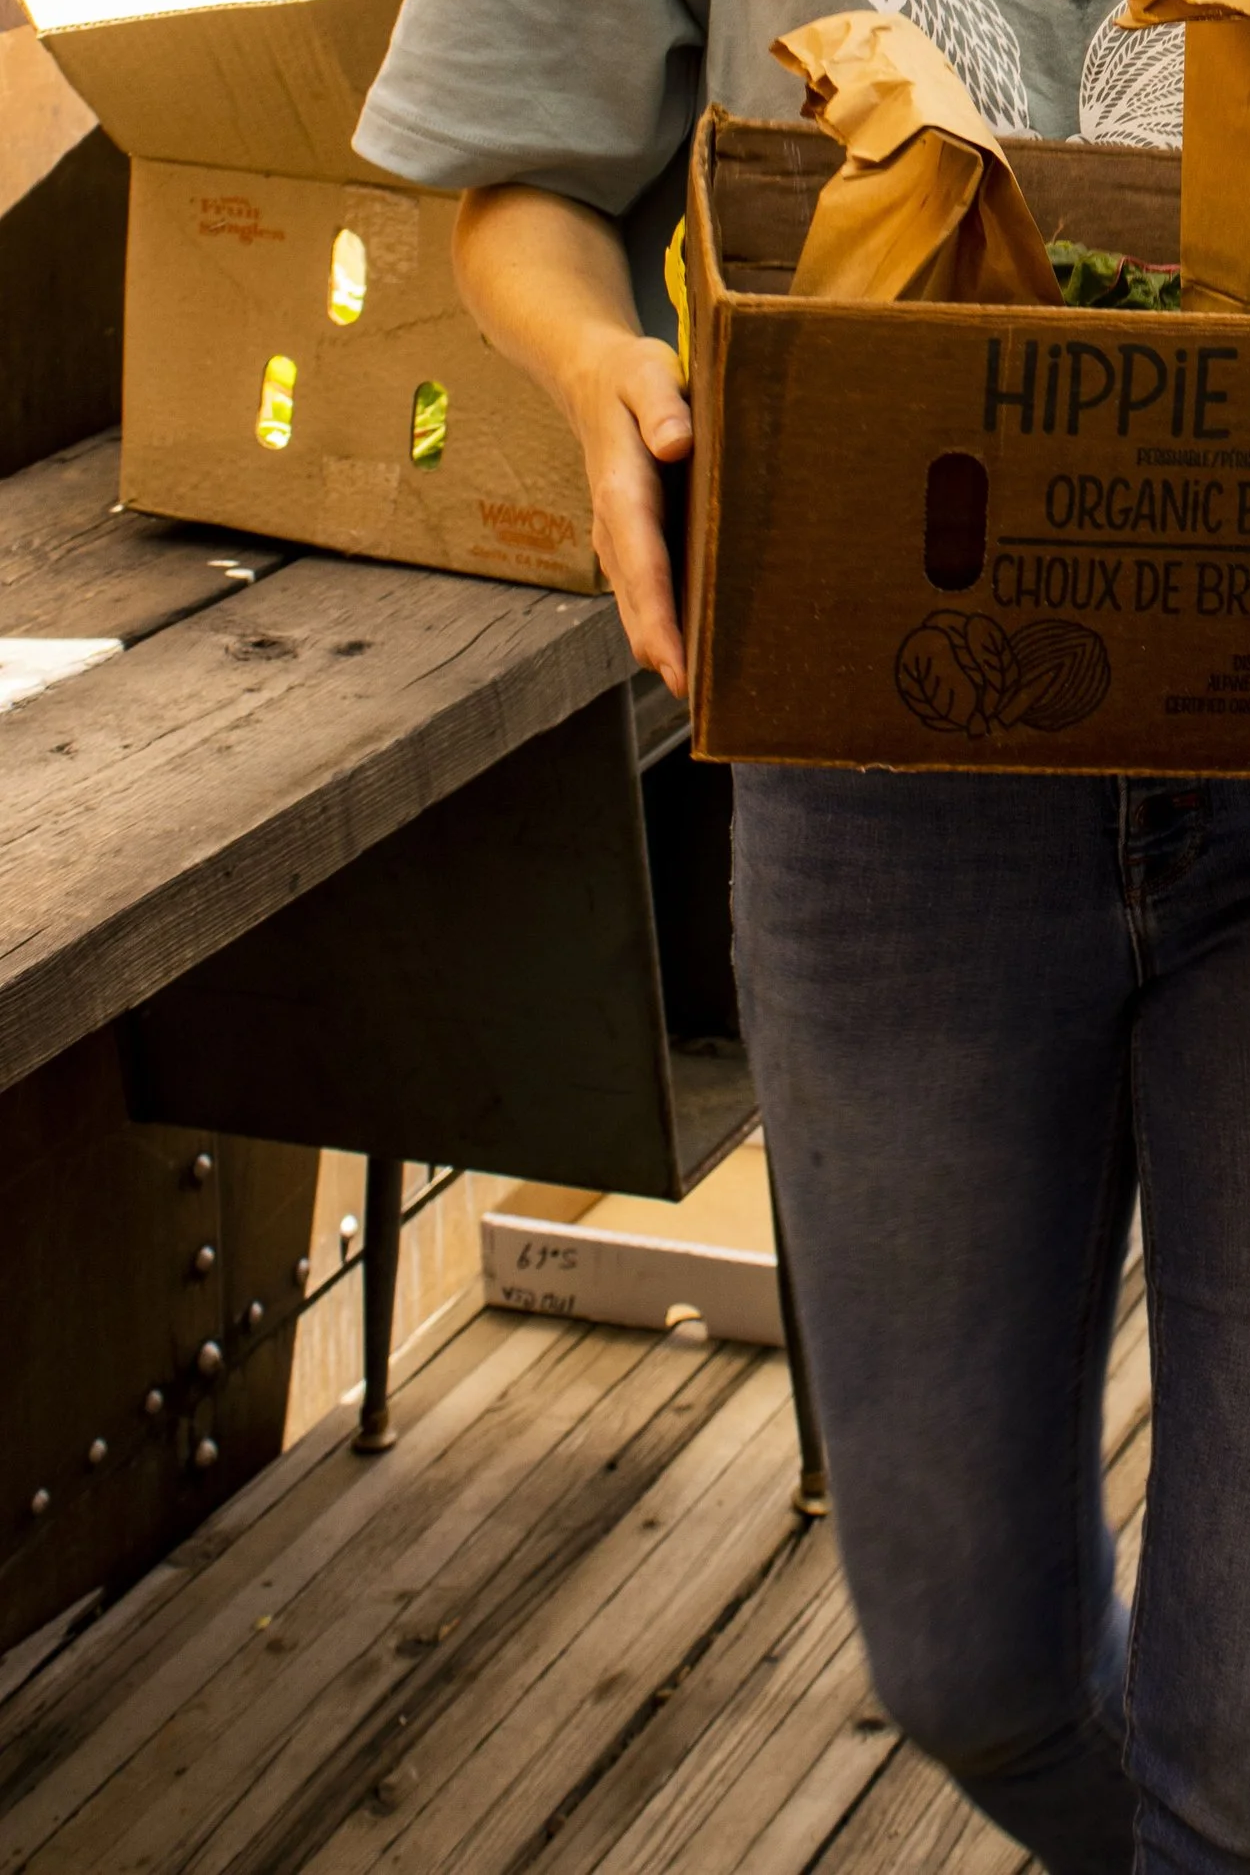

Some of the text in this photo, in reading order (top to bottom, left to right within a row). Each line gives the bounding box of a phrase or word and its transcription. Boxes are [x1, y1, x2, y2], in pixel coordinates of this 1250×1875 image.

[478, 498, 578, 548] WAWONA
[991, 552, 1123, 613] CHOUX
[1134, 560, 1184, 616] DE
